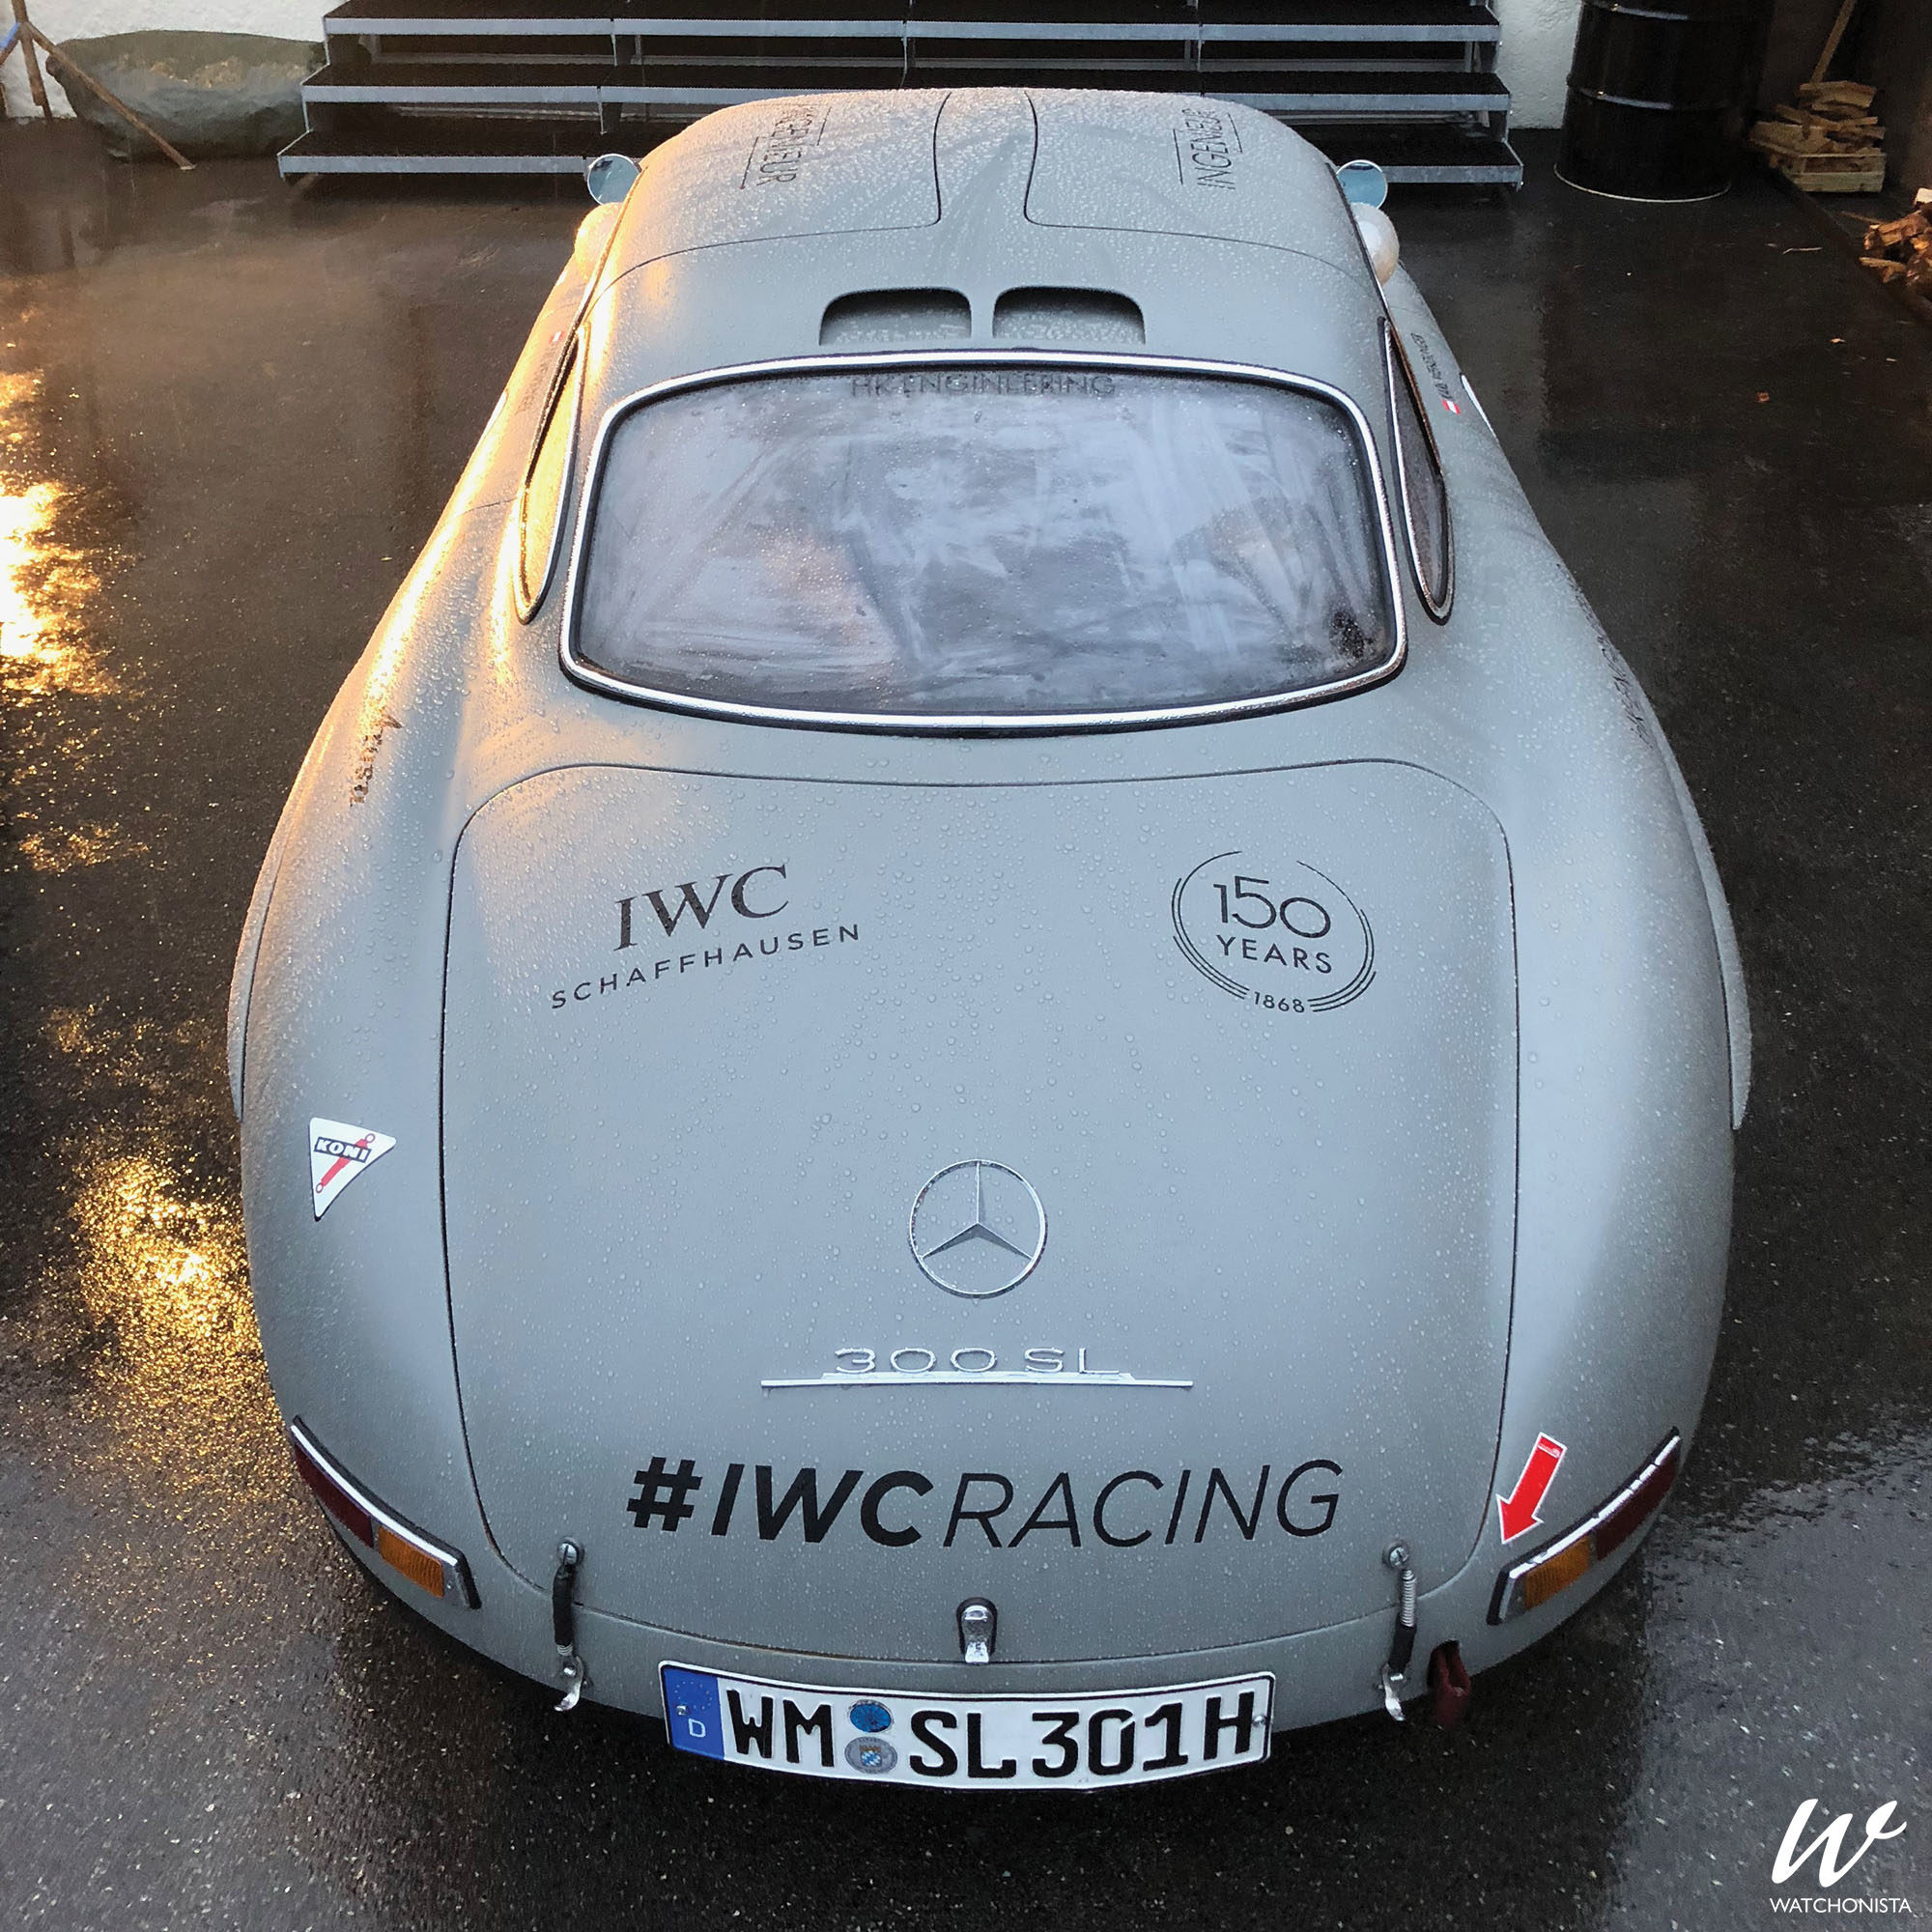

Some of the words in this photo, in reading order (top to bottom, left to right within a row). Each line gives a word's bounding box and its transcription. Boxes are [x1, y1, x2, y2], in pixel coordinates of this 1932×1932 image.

[613, 864, 790, 952] IWC
[1212, 875, 1331, 939] 150
[552, 923, 859, 1009] SCHAFFHAUSEN
[1216, 934, 1332, 974] YEARS
[1254, 991, 1305, 1013] 1868
[315, 1138, 370, 1162] KONI
[834, 1347, 998, 1374] 300
[1023, 1347, 1121, 1375] SL
[688, 1718, 706, 1738] D
[726, 1689, 835, 1768] WM
